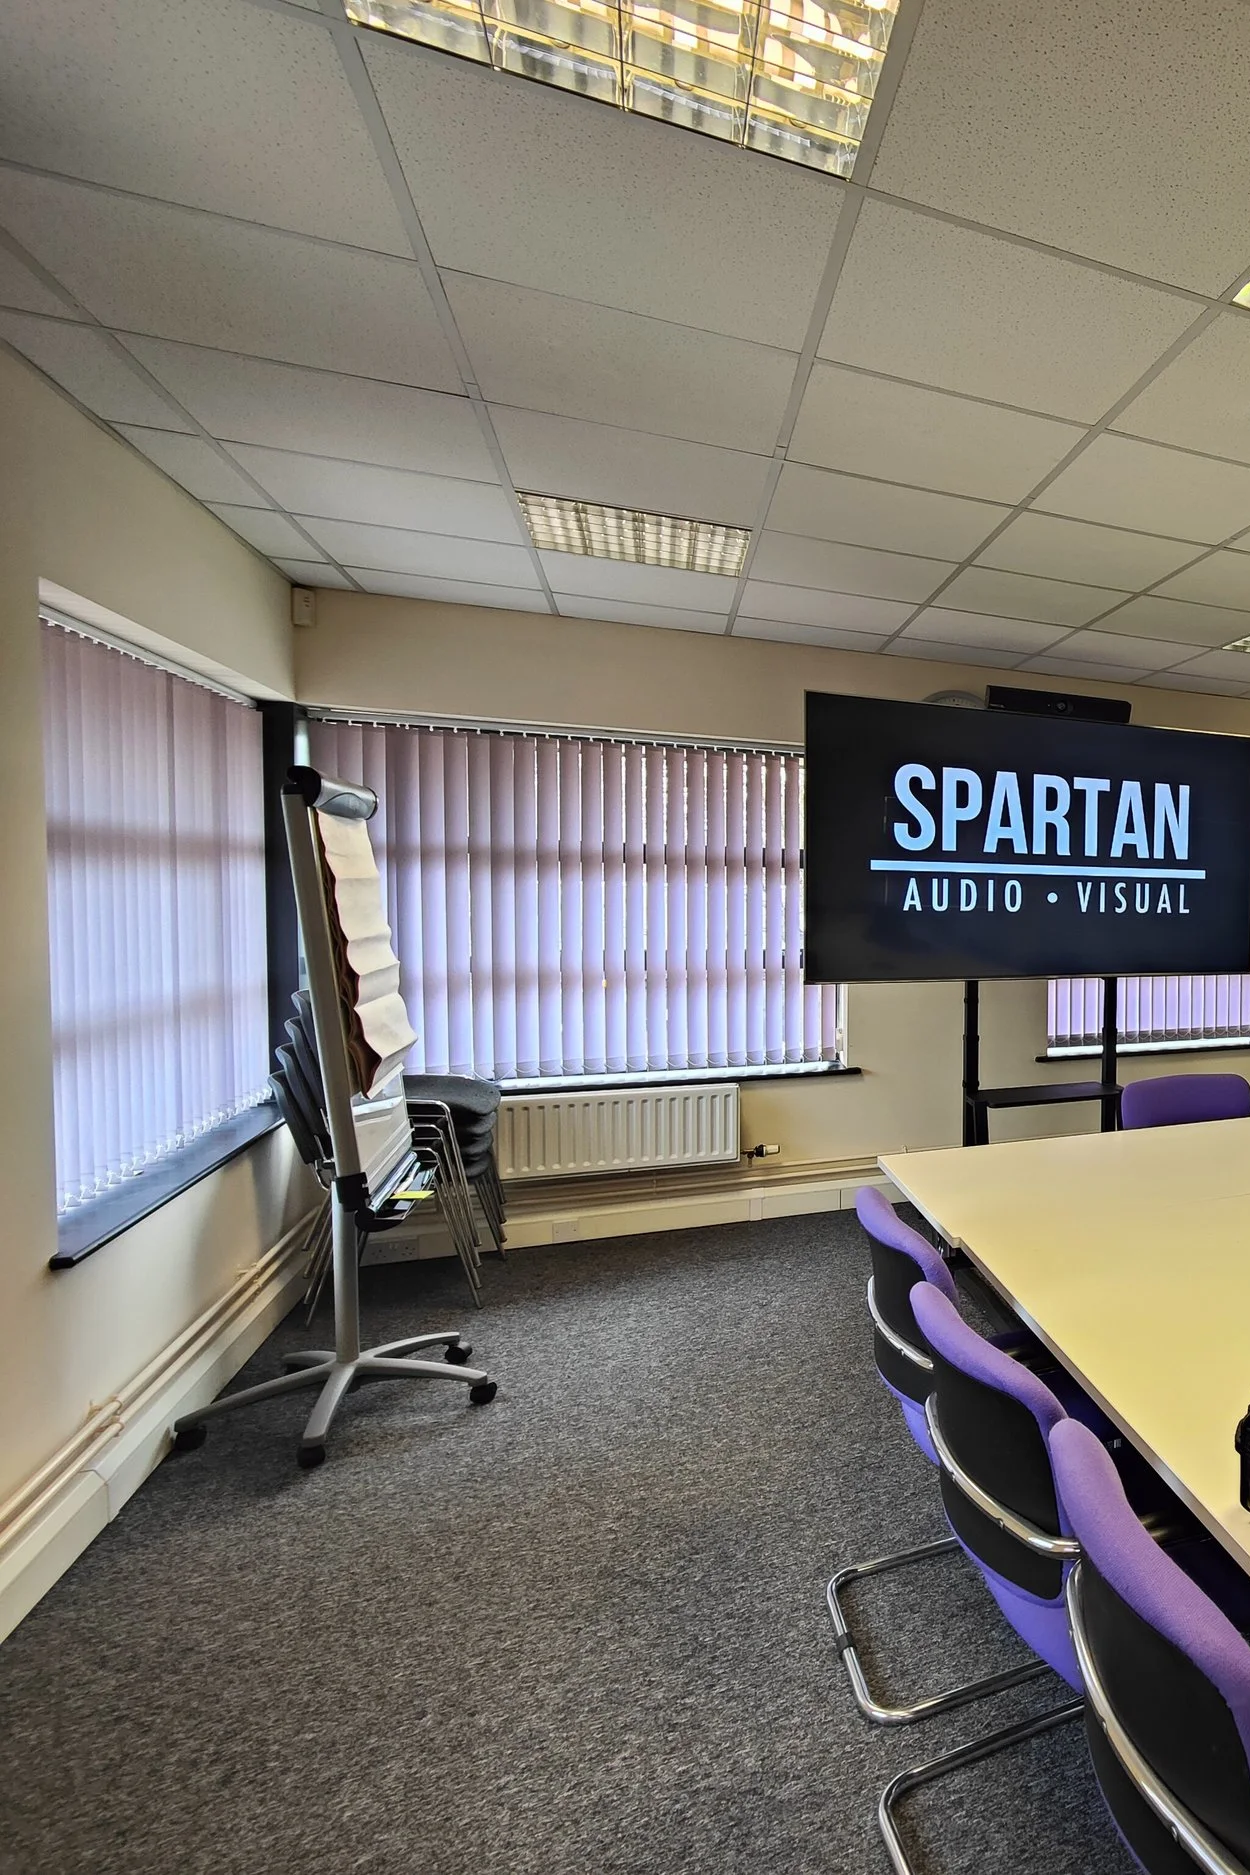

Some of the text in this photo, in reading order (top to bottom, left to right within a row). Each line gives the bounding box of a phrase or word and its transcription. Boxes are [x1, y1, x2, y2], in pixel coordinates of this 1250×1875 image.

[893, 763, 1191, 861] SPARTAN
[902, 876, 1191, 914] AUDIO VISUAL
